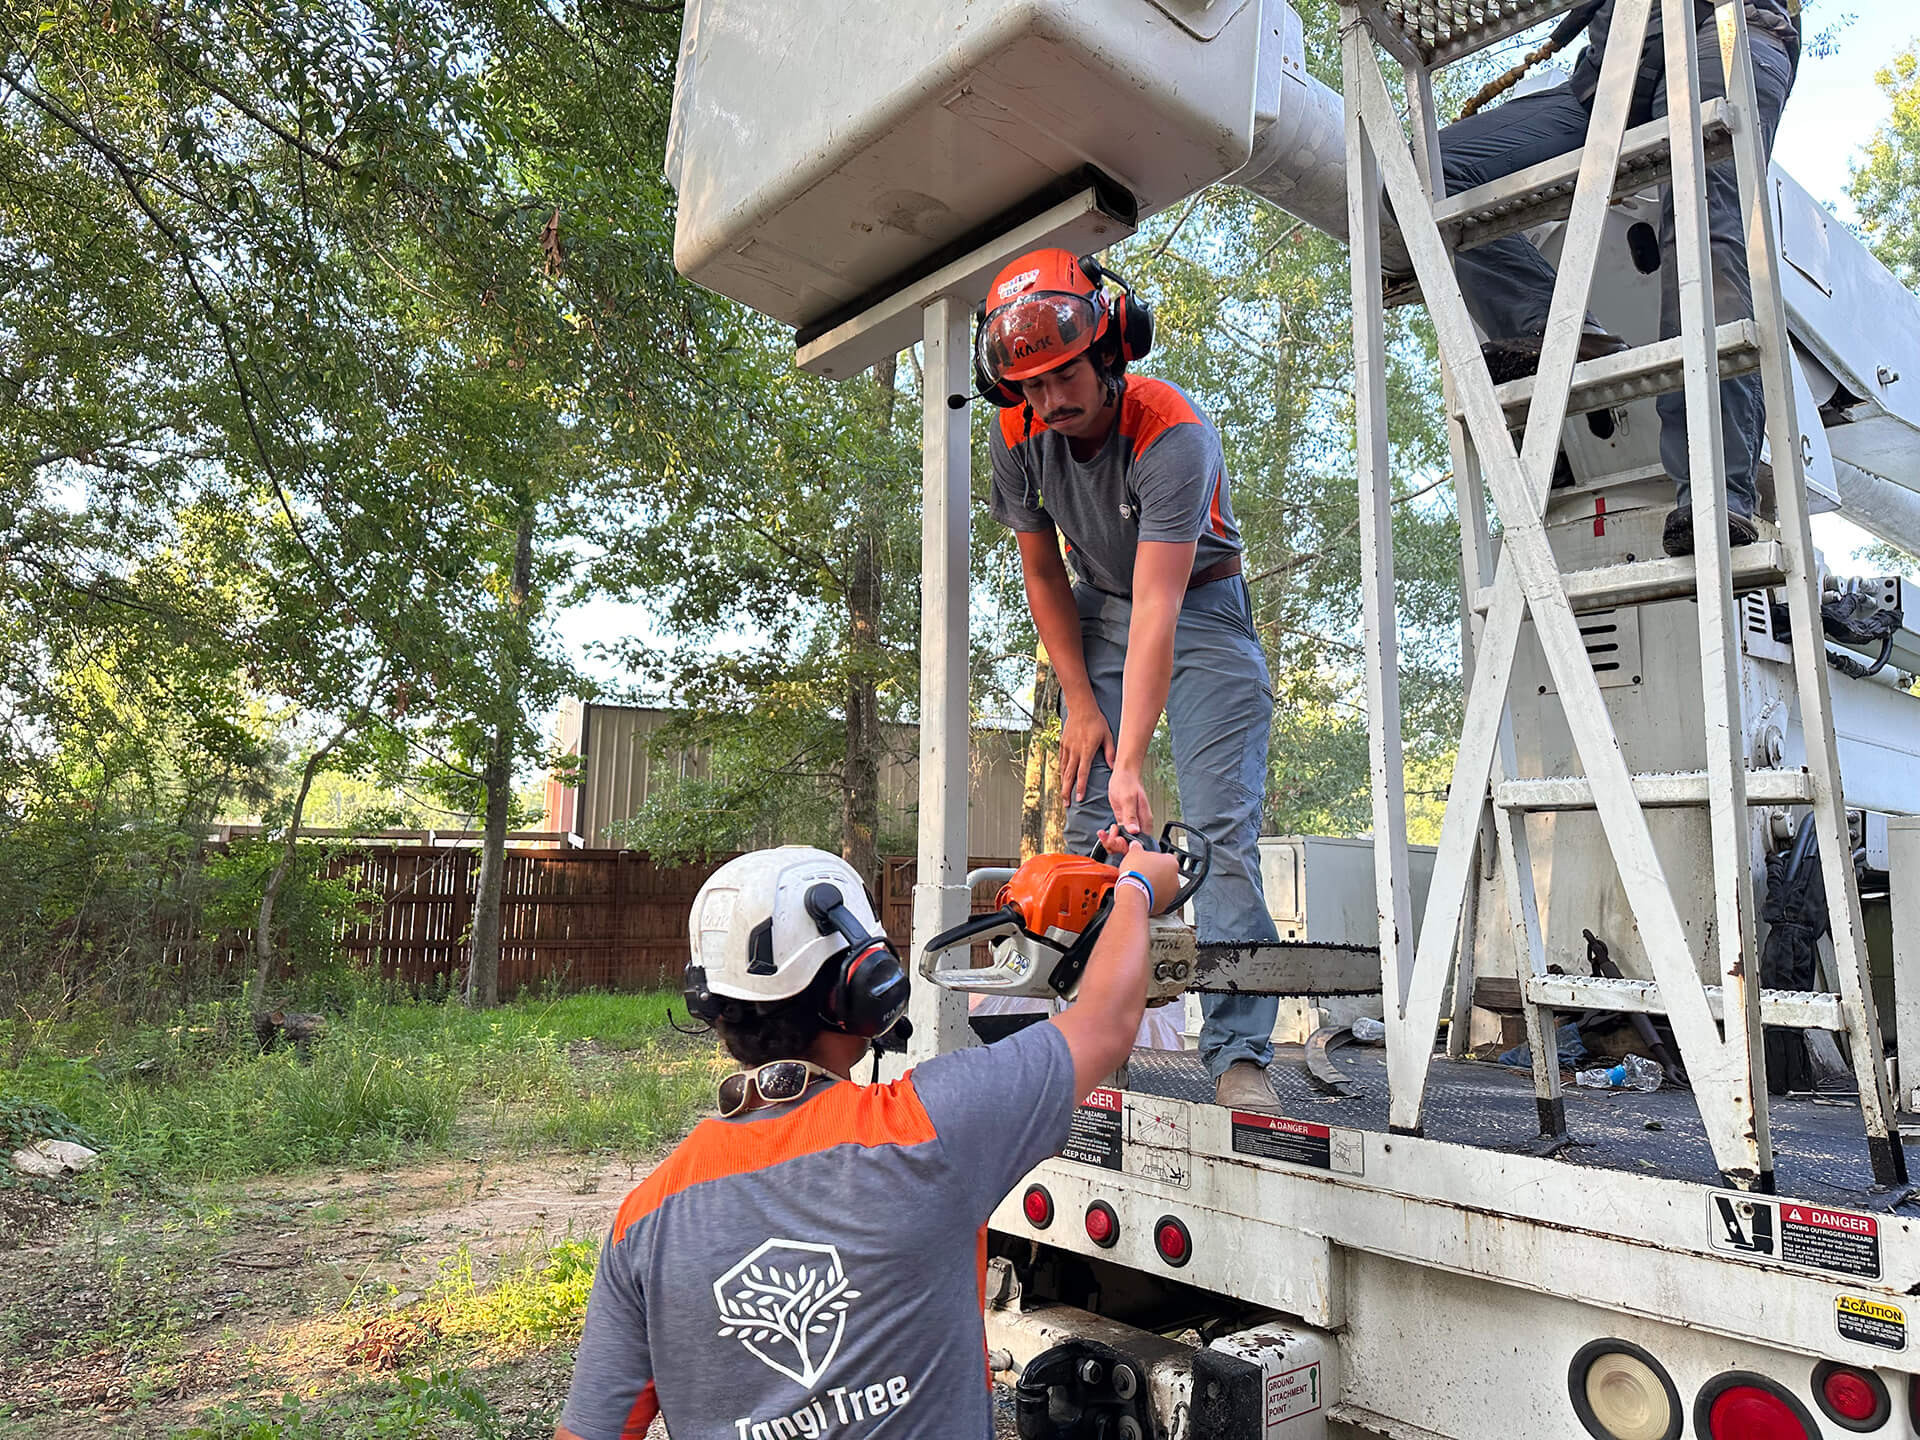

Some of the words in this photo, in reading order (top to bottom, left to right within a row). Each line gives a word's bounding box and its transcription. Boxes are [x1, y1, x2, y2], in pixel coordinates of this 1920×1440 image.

[1277, 1121, 1309, 1134] DANGER
[1062, 1148, 1079, 1158] KEEP
[1079, 1152, 1102, 1164] CLEAR
[1812, 1212, 1869, 1231] DANGER
[1786, 1223, 1809, 1232] MOVING
[1810, 1228, 1846, 1238] OUTRIGGER
[1847, 1233, 1873, 1243] HAZARD
[1851, 1302, 1901, 1320] CAUTION
[1268, 1376, 1295, 1392] GROUND
[827, 1375, 911, 1425] Tree
[1268, 1384, 1308, 1404] ATTACHMENT
[1269, 1404, 1287, 1417] POINT
